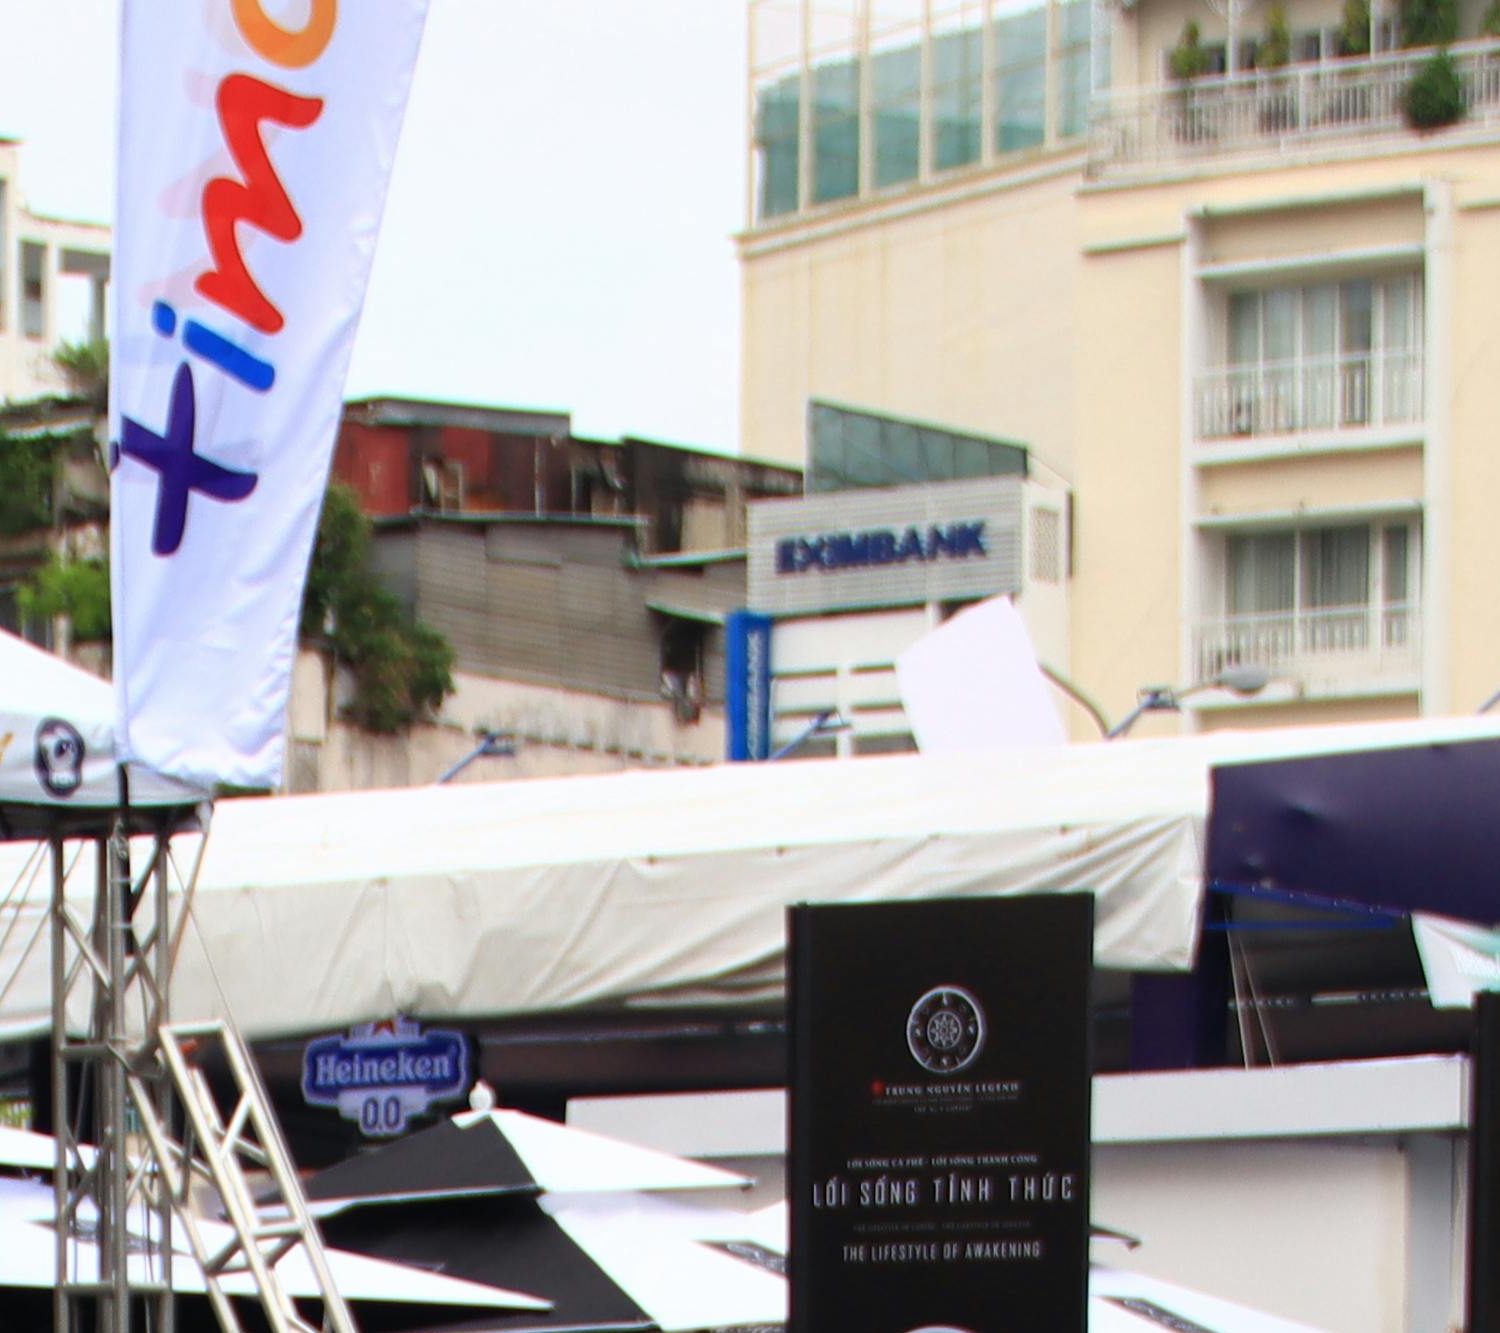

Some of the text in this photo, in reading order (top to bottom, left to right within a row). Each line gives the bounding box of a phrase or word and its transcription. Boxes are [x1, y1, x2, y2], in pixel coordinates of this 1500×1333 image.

[774, 518, 988, 576] EXIMBANK
[315, 1051, 451, 1086] Heineken
[885, 1085, 921, 1097] TRUNG
[975, 1082, 1020, 1094] LEGEND
[843, 1240, 1042, 1262] THE LIFESTYLE OF AWAKENING
